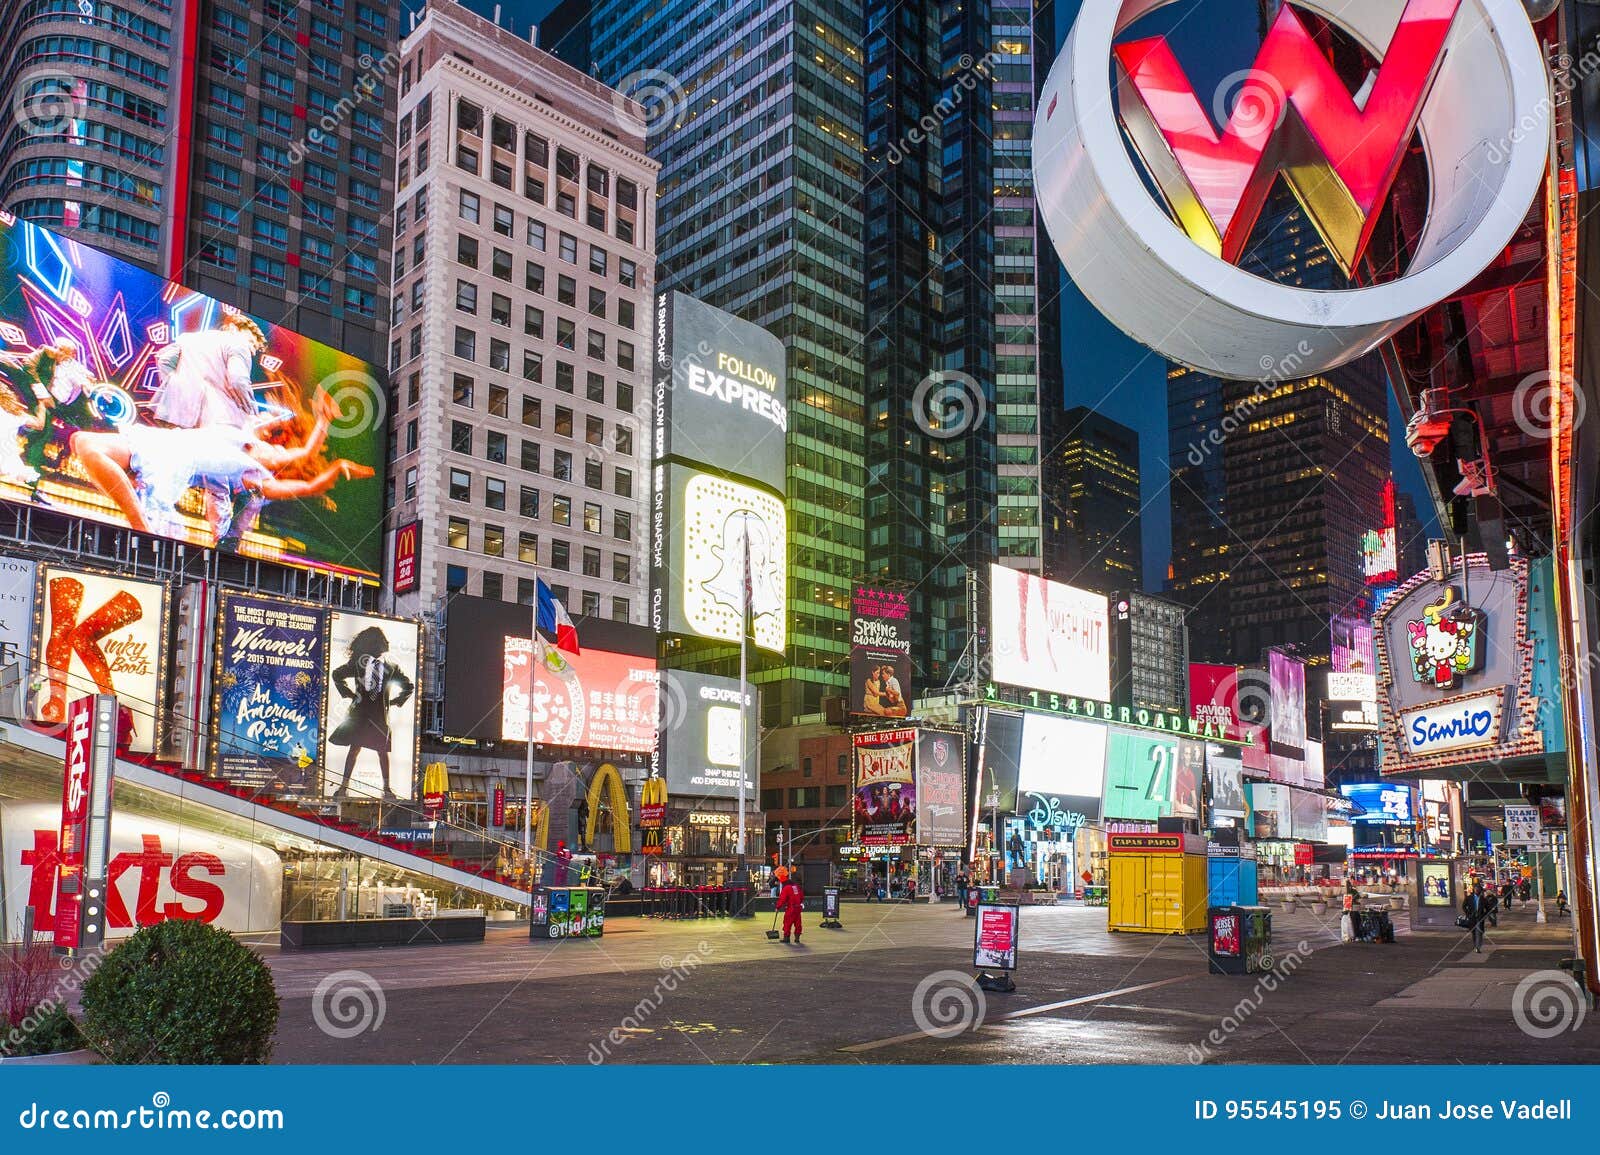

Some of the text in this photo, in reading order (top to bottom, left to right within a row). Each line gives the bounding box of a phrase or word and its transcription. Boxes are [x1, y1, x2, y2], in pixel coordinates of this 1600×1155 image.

[657, 308, 667, 363] SNAPCHAT
[718, 352, 777, 392] FOLLOW
[656, 381, 665, 426] FOLLOW
[688, 363, 787, 433] EXPRESS
[654, 513, 663, 569] SNAPCHAT
[399, 565, 412, 579] 24
[233, 605, 317, 625] THE MOST AWARD-WINNING
[653, 588, 662, 633] FOLLOW
[1118, 612, 1128, 620] LG
[236, 613, 266, 626] MUSICAL
[265, 617, 275, 626] OF
[275, 618, 288, 629] THE
[854, 617, 898, 638] SPRING
[231, 626, 318, 657] Winner!
[853, 634, 911, 655] awakening
[108, 657, 154, 677] Boots
[231, 649, 315, 669] 4 2015 TONY AWARDS
[250, 682, 271, 705] An
[700, 686, 751, 707] @EXPRES
[1210, 697, 1217, 706] A
[236, 696, 309, 732] American
[1195, 704, 1232, 717] SAVIOR
[1196, 714, 1232, 726] IS BORN
[246, 720, 293, 744] Paris
[590, 722, 609, 732] Wish
[1412, 709, 1492, 746] Sanrio
[589, 732, 618, 746] Happy
[864, 733, 878, 743] BIG
[880, 732, 895, 742] FAT
[67, 706, 90, 813] tkts
[690, 776, 703, 784] ADD
[704, 777, 729, 786] EXPRESS
[689, 813, 731, 825] EXPRESS
[839, 846, 861, 854] GIFTS
[1114, 838, 1177, 847] TAPAS PAPAS
[20, 829, 226, 930] tkts
[1215, 917, 1236, 930] JERSEY
